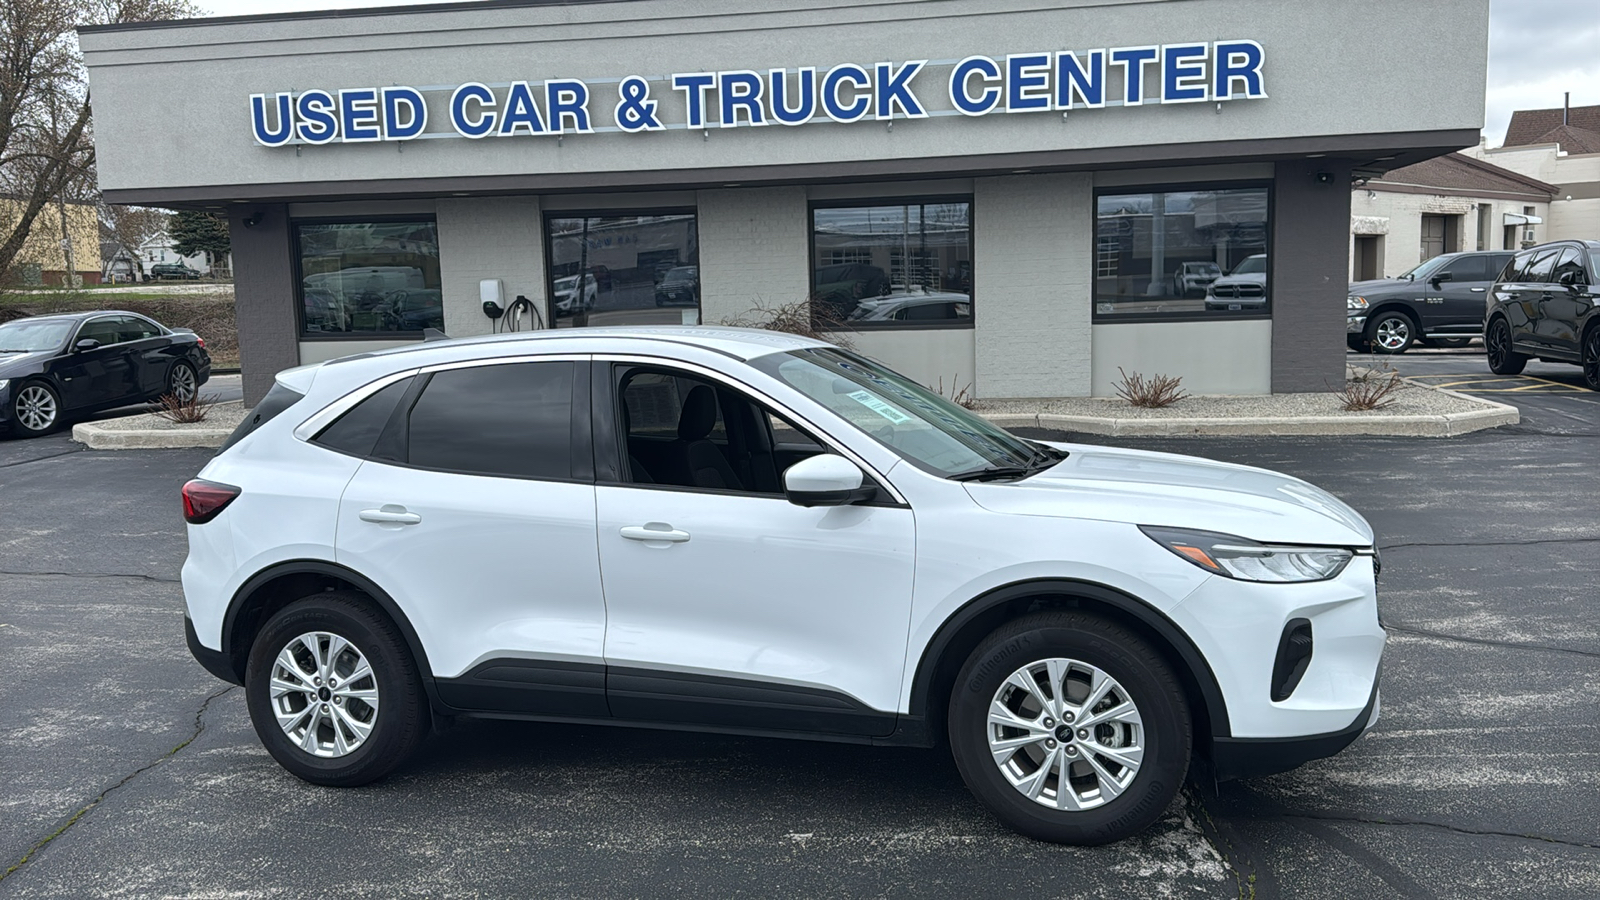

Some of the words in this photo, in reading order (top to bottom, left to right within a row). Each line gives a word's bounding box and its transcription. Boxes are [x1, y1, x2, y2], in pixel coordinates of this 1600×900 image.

[249, 85, 428, 147] USED
[449, 78, 595, 139] CAR
[613, 74, 667, 133] &
[671, 59, 929, 129] TRUCK
[948, 38, 1269, 117] CENTER
